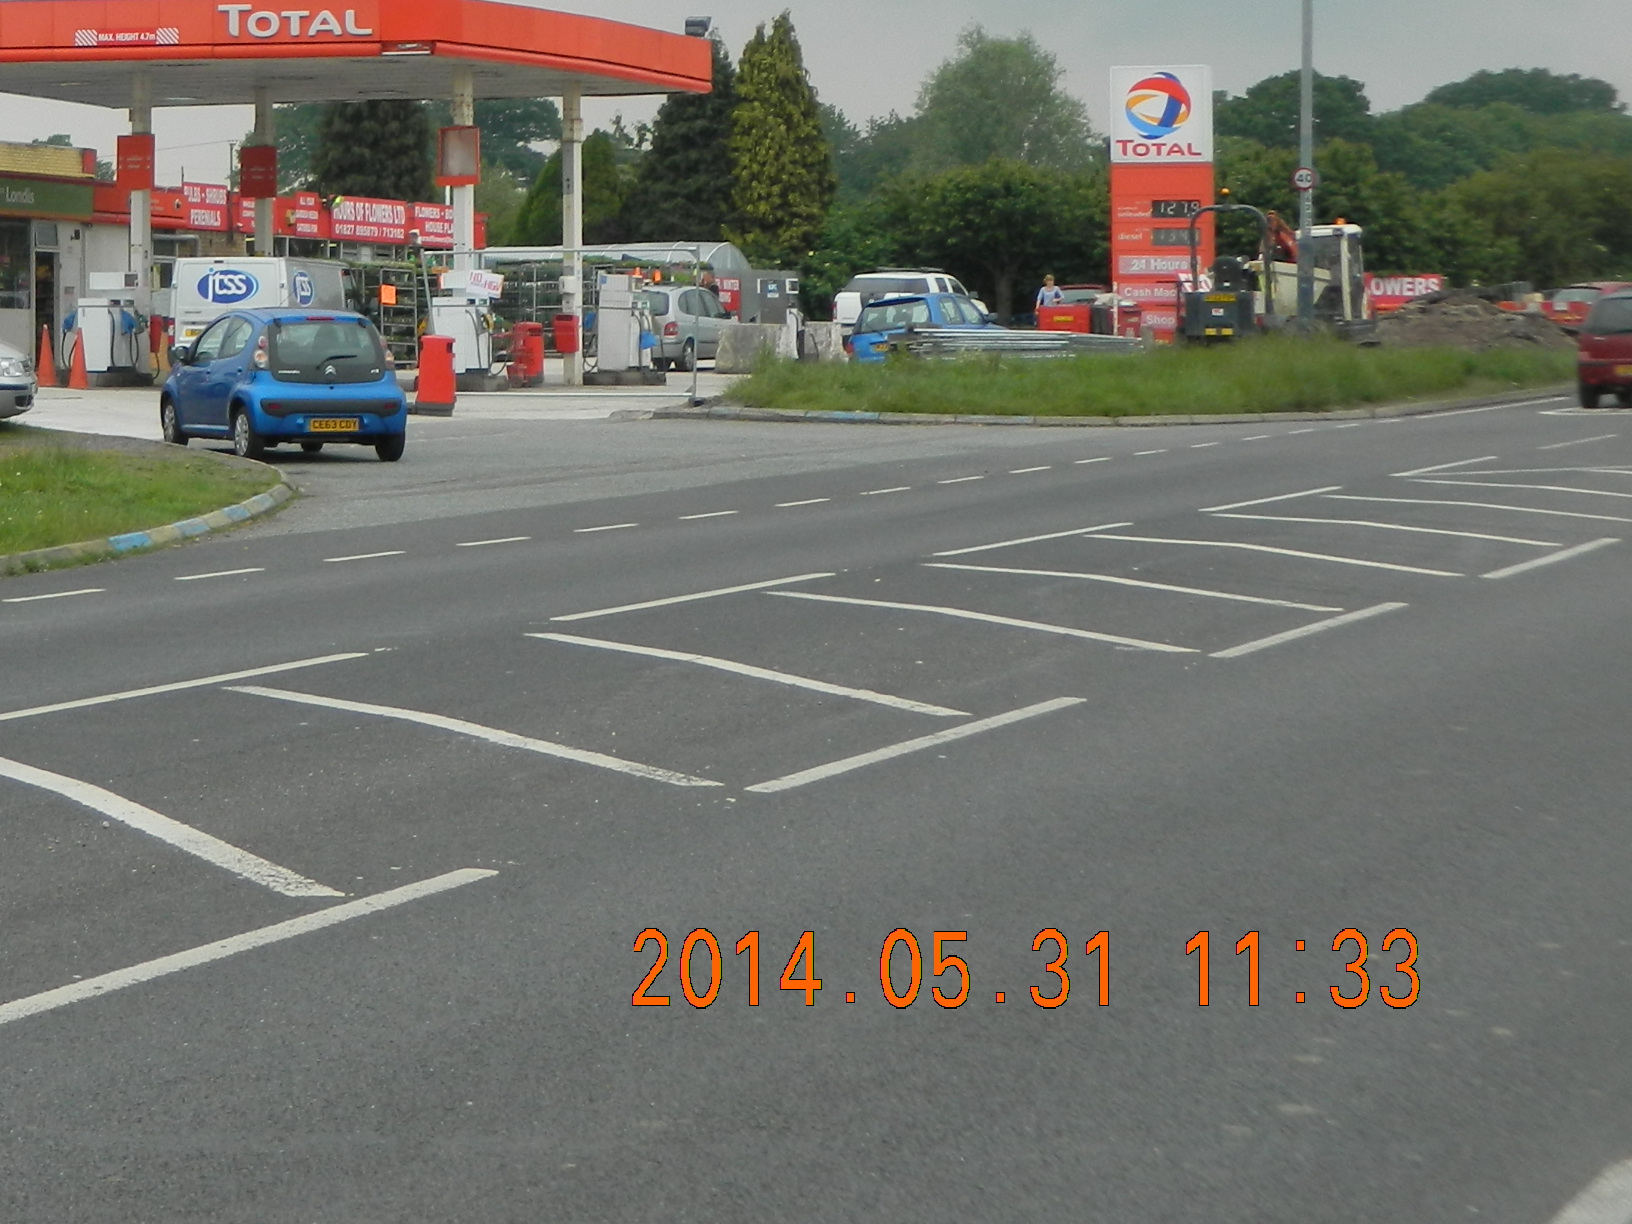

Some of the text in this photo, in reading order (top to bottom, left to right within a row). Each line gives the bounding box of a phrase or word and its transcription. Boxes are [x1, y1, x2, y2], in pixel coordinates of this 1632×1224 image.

[218, 4, 373, 37] TOTAL
[115, 32, 139, 42] HEIGHT
[1115, 139, 1203, 157] TOTAL
[1296, 173, 1312, 183] 40
[6, 186, 35, 204] Londis
[356, 201, 364, 222] OF
[365, 202, 393, 224] FLOWERS
[394, 205, 406, 225] LTD
[334, 223, 355, 236] 01827
[1150, 258, 1188, 270] Hours
[1124, 287, 1177, 297] Cash Mac
[1370, 277, 1441, 296] OWERS
[1146, 314, 1176, 326] Shop
